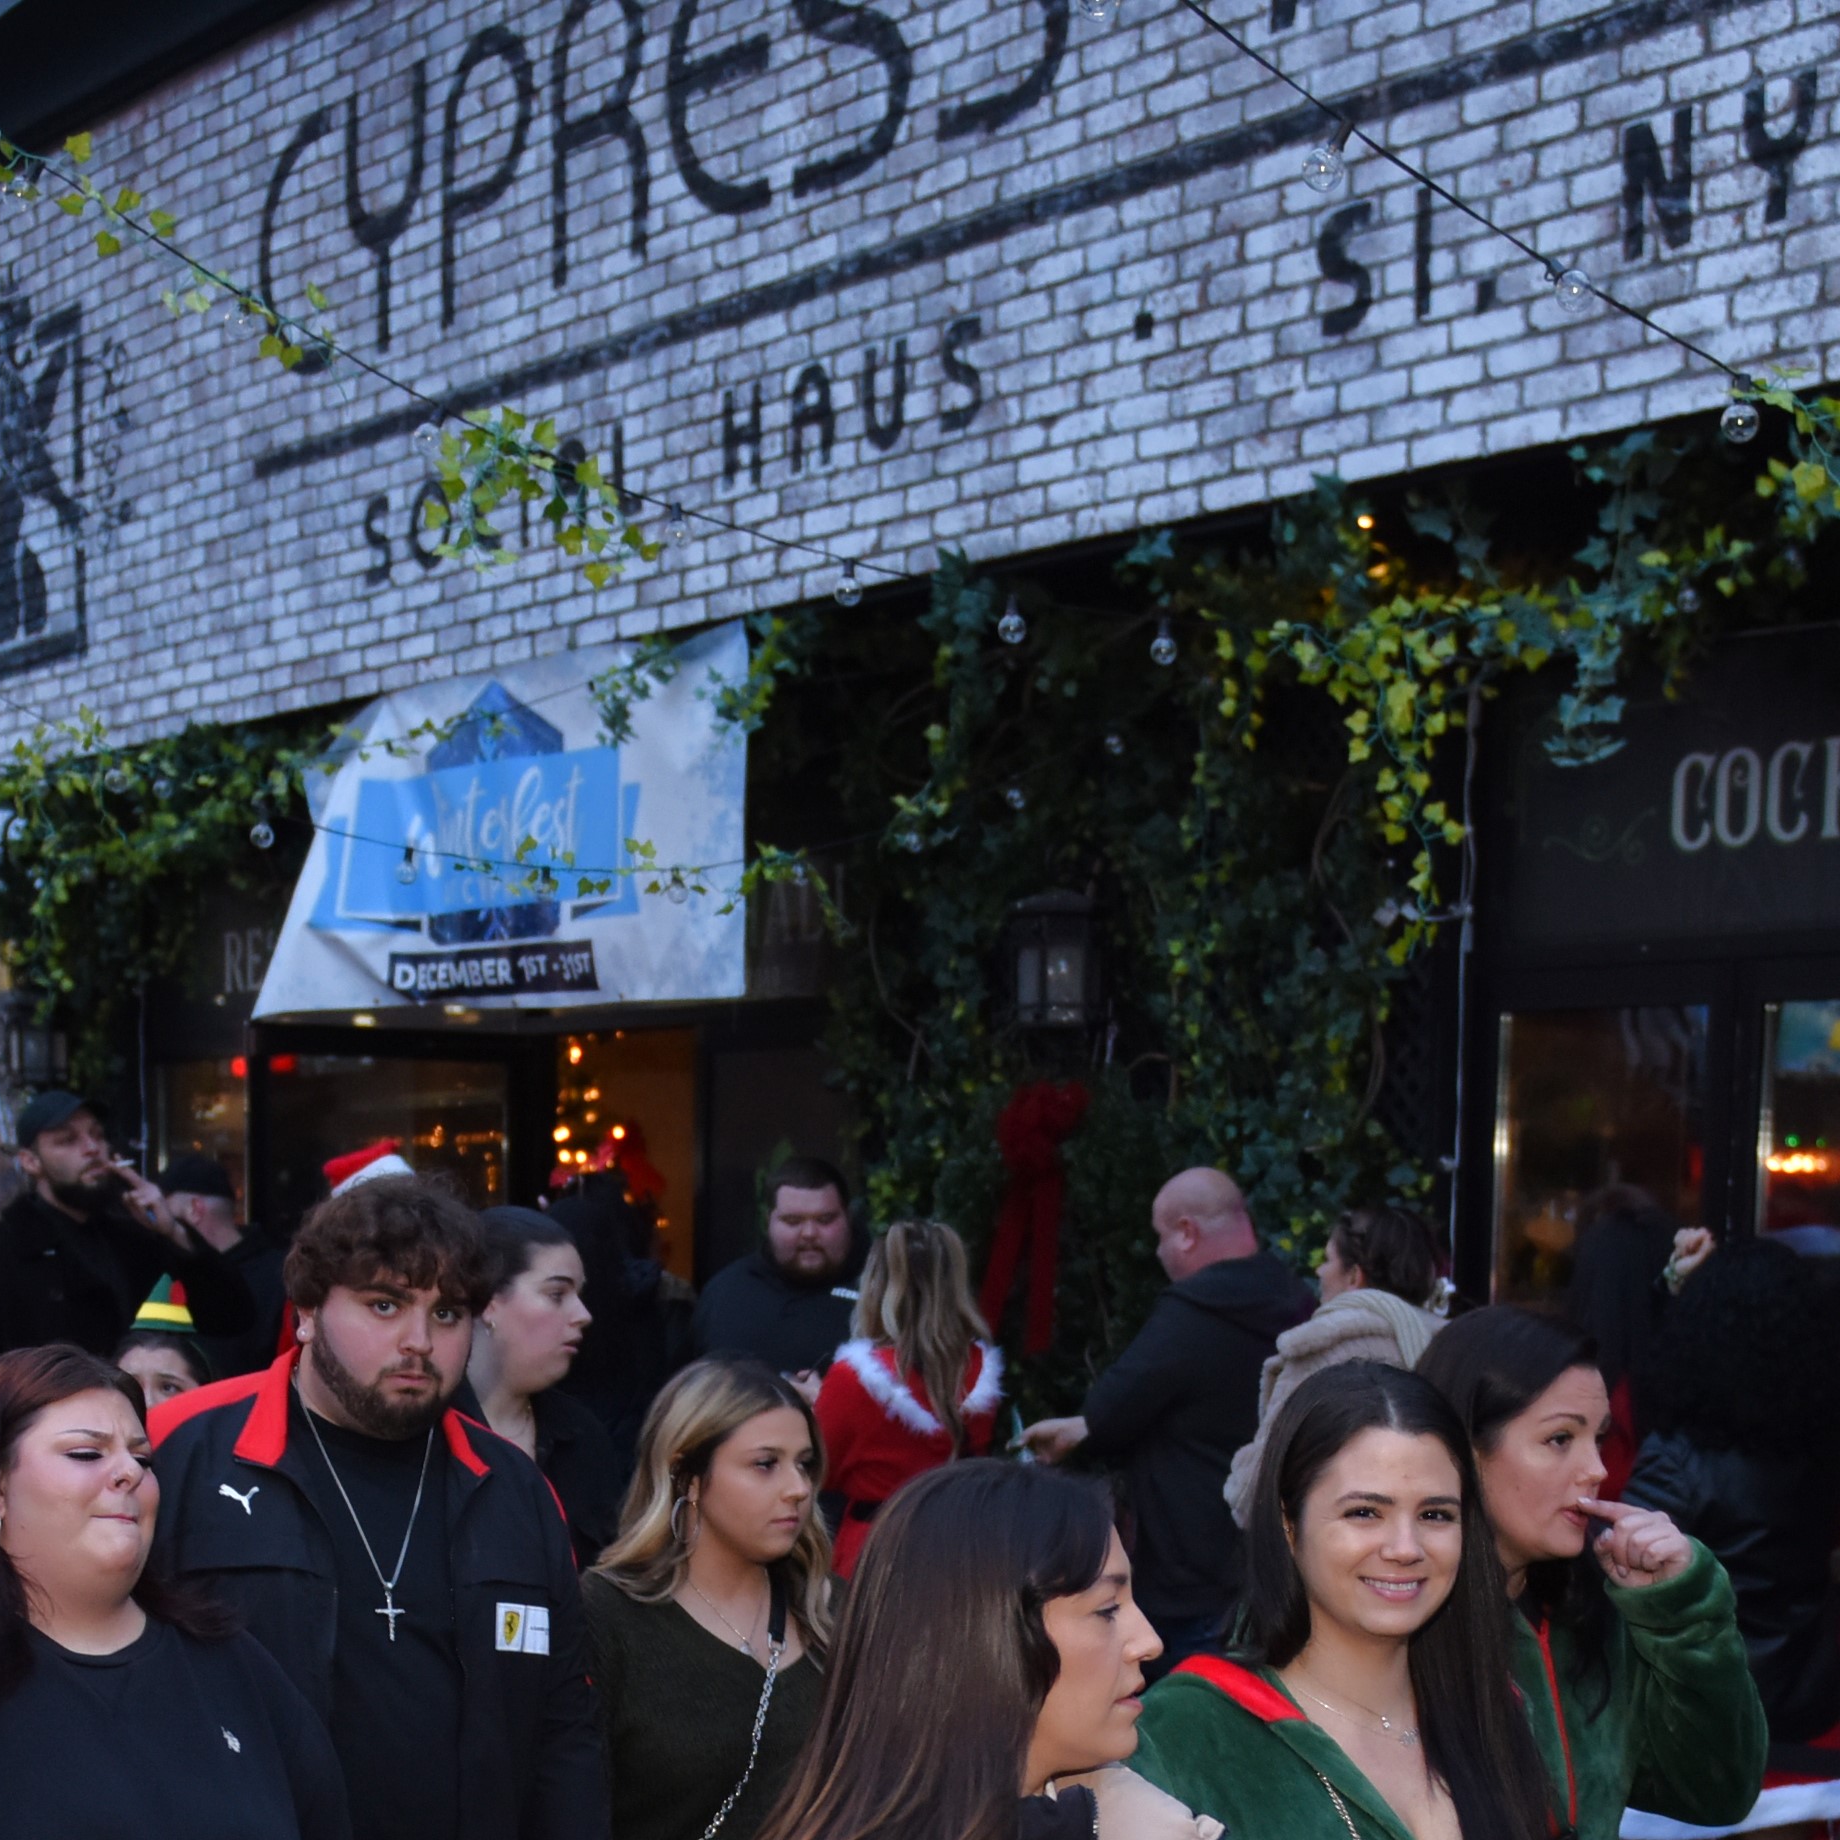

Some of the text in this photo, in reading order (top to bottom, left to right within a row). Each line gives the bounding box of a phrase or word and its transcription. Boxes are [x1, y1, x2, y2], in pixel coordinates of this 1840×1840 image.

[722, 315, 982, 493] HAUS
[1622, 66, 1818, 263] NY
[393, 957, 514, 991] DECEMBER
[518, 953, 548, 983] 1ST
